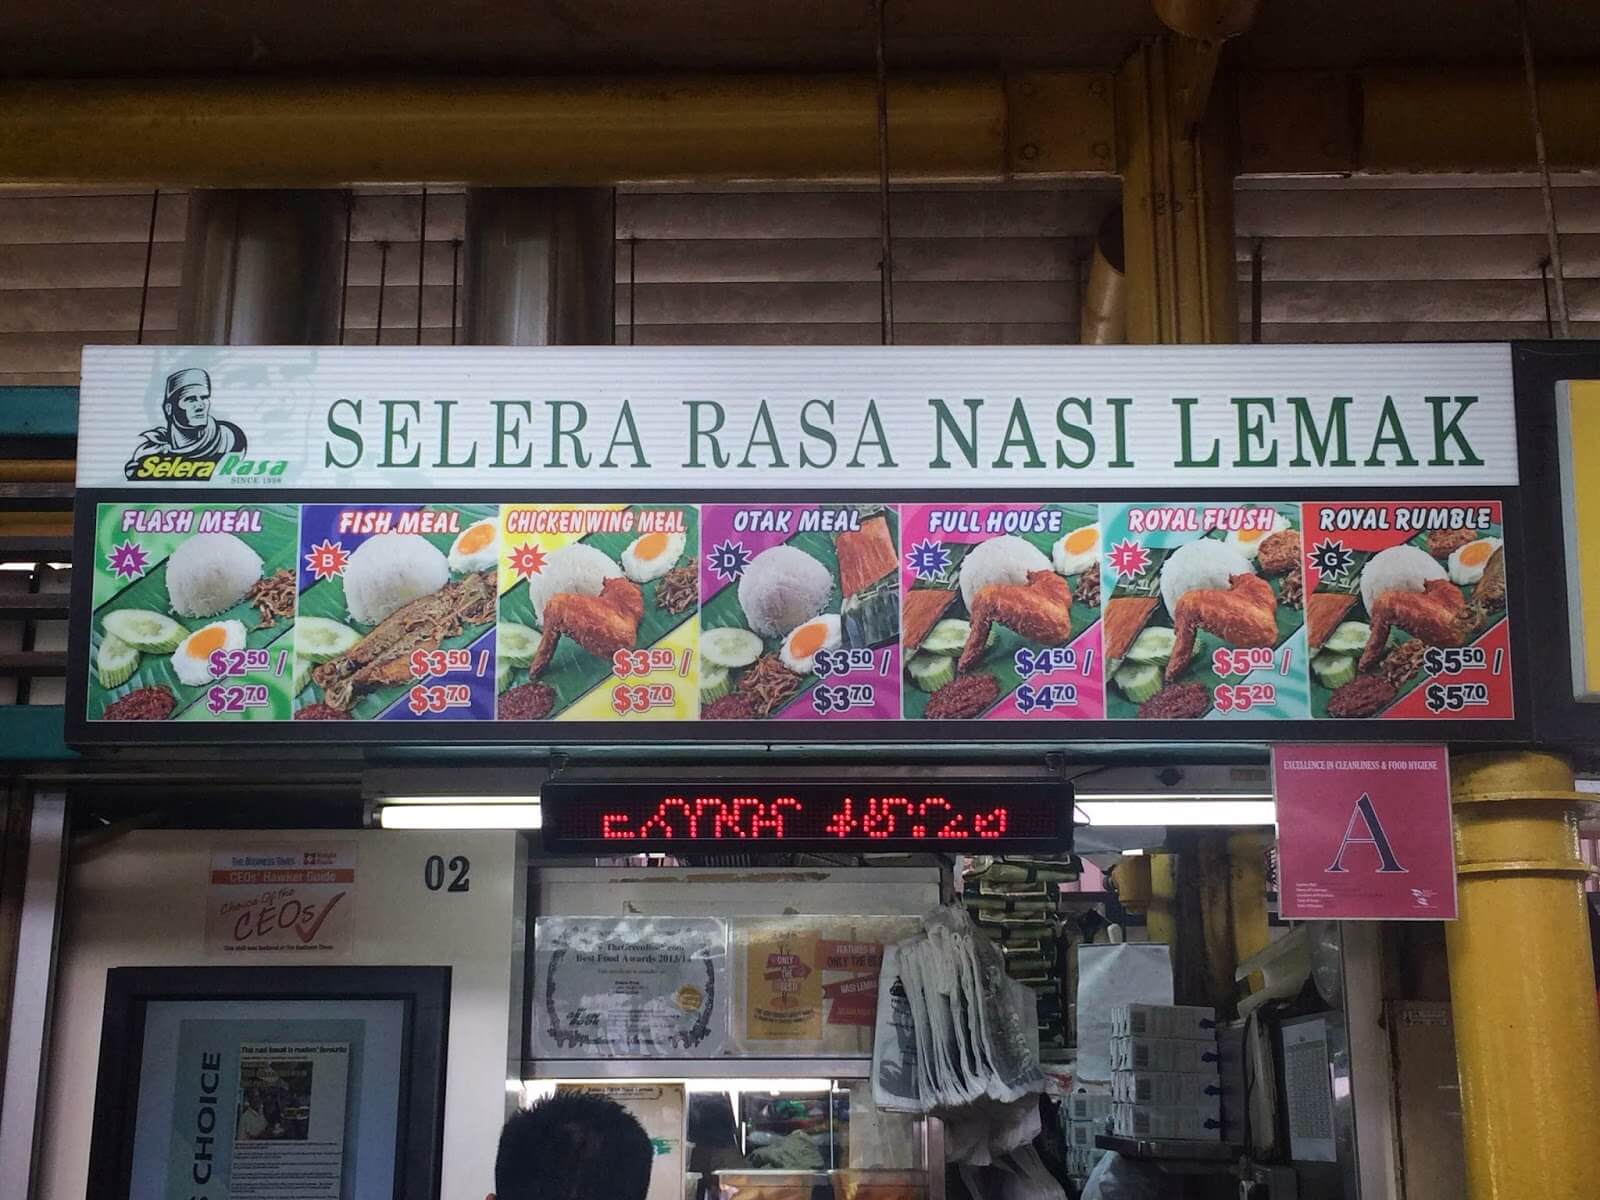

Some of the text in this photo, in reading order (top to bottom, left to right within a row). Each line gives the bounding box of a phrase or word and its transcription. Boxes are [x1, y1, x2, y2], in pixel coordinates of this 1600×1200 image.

[325, 395, 1485, 469] SELERA RASA NASI LEMAK
[219, 454, 289, 476] Rasa
[231, 476, 258, 484] SINCE
[121, 510, 263, 533] FLASH MEAL
[339, 511, 461, 534] FISH MEAL
[637, 510, 686, 534] MEAL
[733, 510, 861, 533] OTAK MEAL
[928, 509, 1064, 533] FULL HOUSE
[1128, 507, 1276, 532] ROYAL FLUSH
[1319, 506, 1492, 531] ROYAL RUMBLE
[122, 554, 136, 568] A
[322, 554, 334, 568] B
[522, 554, 535, 568] C
[724, 553, 736, 568] D
[922, 552, 934, 566] E
[1122, 552, 1133, 565] F
[1324, 552, 1338, 566] G
[1283, 760, 1325, 770] EXCELLENCE
[1335, 760, 1380, 770] CLEANLINESS
[1381, 760, 1387, 770] &
[1388, 760, 1407, 770] FOOD
[1408, 760, 1438, 770] HYGIENE
[1324, 791, 1409, 873] A
[425, 855, 470, 892] 02
[234, 900, 316, 941] CEOs
[576, 954, 595, 963] Best
[598, 954, 620, 963] Food
[622, 954, 657, 963] Awards
[193, 1052, 221, 1185] CHOICE
